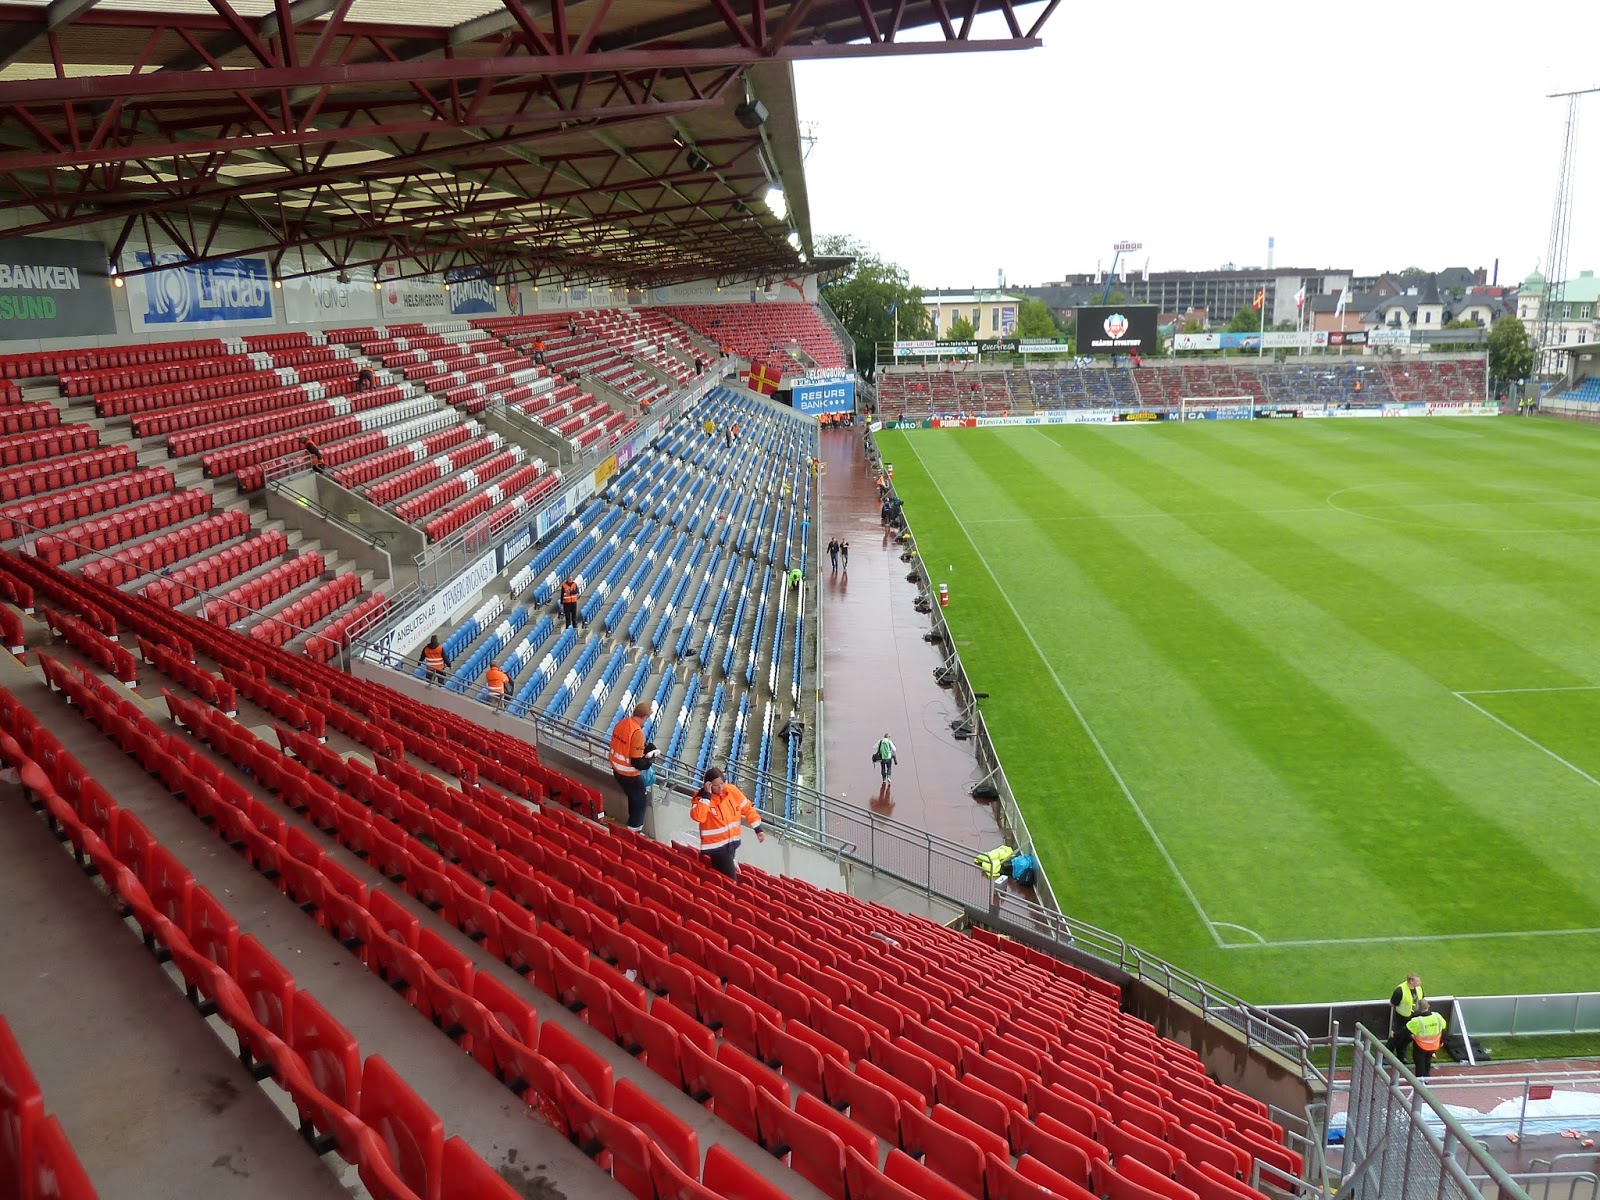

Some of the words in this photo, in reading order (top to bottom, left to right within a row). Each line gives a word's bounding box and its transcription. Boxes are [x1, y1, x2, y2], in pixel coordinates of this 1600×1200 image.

[0, 264, 80, 290] BANKEN
[199, 268, 265, 309] Lindab
[0, 295, 57, 320] SUND
[403, 294, 444, 308] HELSINGBORG
[801, 389, 846, 401] RESURS
[801, 400, 828, 410] BANK
[1168, 411, 1206, 420] MCA
[939, 419, 960, 427] PUMA
[396, 612, 428, 642] ANBULTEN
[427, 603, 436, 618] AB
